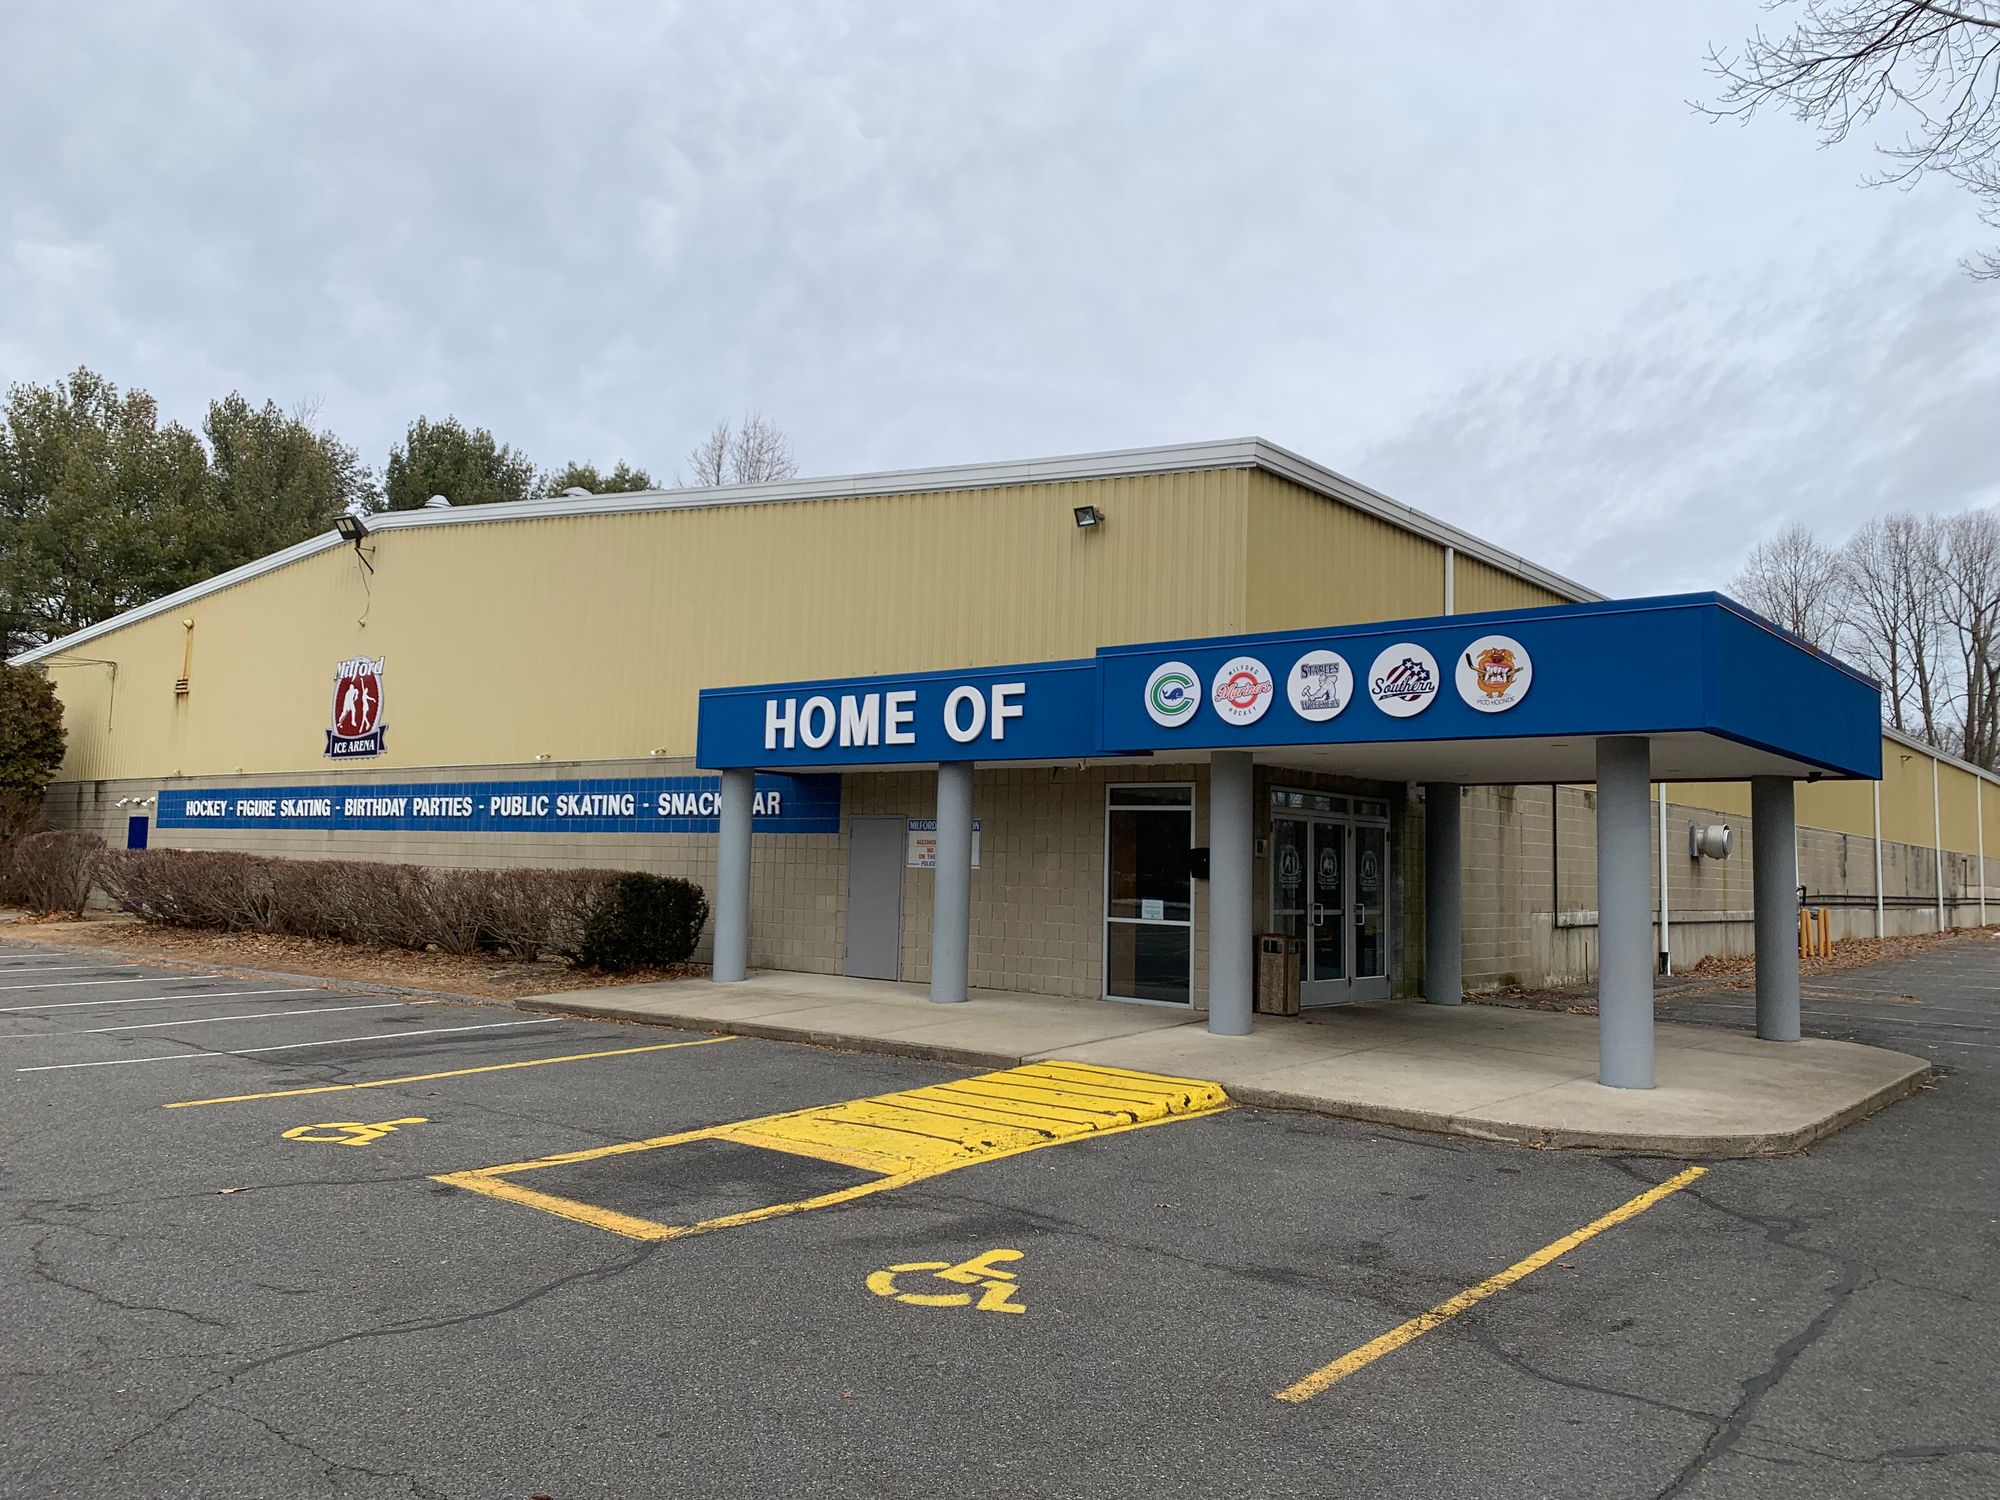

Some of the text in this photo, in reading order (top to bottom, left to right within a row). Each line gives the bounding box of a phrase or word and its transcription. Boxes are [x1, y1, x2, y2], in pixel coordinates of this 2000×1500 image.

[334, 656, 385, 682] Milford
[1228, 664, 1259, 676] MILFORD
[1214, 680, 1272, 702] Mariners
[1371, 677, 1435, 695] Southern
[764, 682, 1026, 749] HOME OF
[1228, 706, 1258, 717] HOCKEY
[333, 740, 376, 754] ICE ARENA
[185, 800, 228, 817] HOCKEY
[236, 800, 276, 817] FIGURE
[280, 799, 331, 817] SKATING
[344, 798, 408, 817] BIRTHDAY
[412, 797, 473, 817] PARTIES
[490, 795, 549, 817] PUBLIC
[556, 794, 635, 817] SKATING
[657, 792, 722, 816] SNACK
[752, 791, 781, 815] AR
[909, 821, 937, 830] MILFORD
